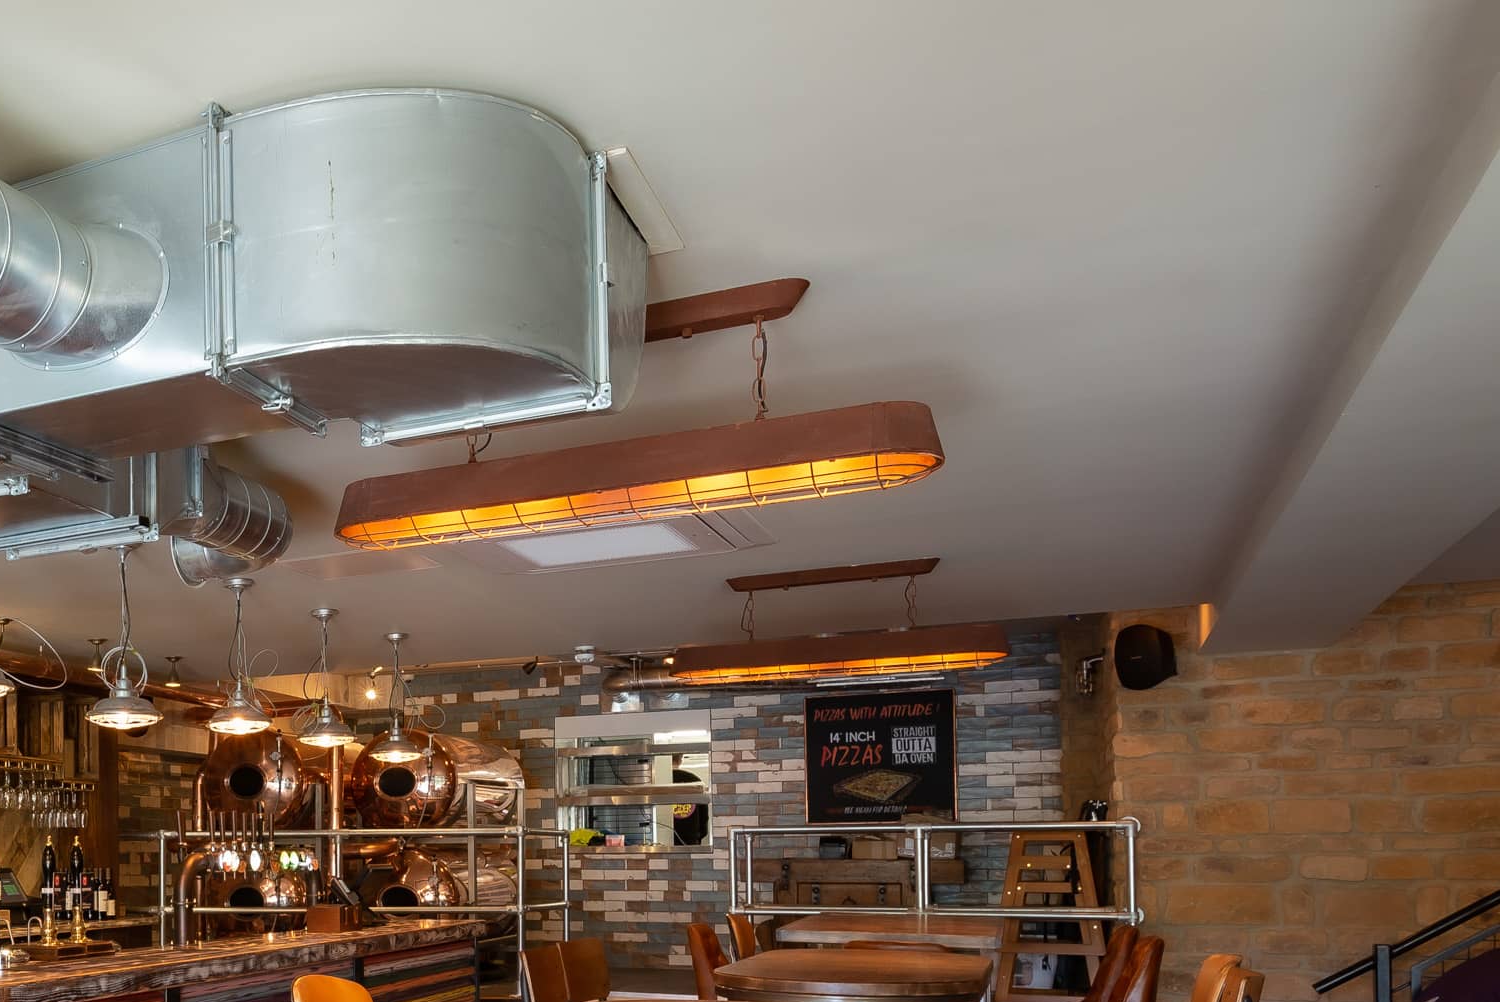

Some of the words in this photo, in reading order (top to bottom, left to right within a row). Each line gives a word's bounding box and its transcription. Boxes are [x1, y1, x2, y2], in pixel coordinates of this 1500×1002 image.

[814, 708, 846, 721] PIZZAS
[850, 706, 877, 720] WITH
[845, 731, 876, 742] INCH
[893, 726, 935, 738] STRAIGHT
[895, 738, 933, 752] OUTTA
[821, 744, 883, 768] PIZZAS
[895, 753, 908, 764] DA
[911, 752, 934, 764] OVEN
